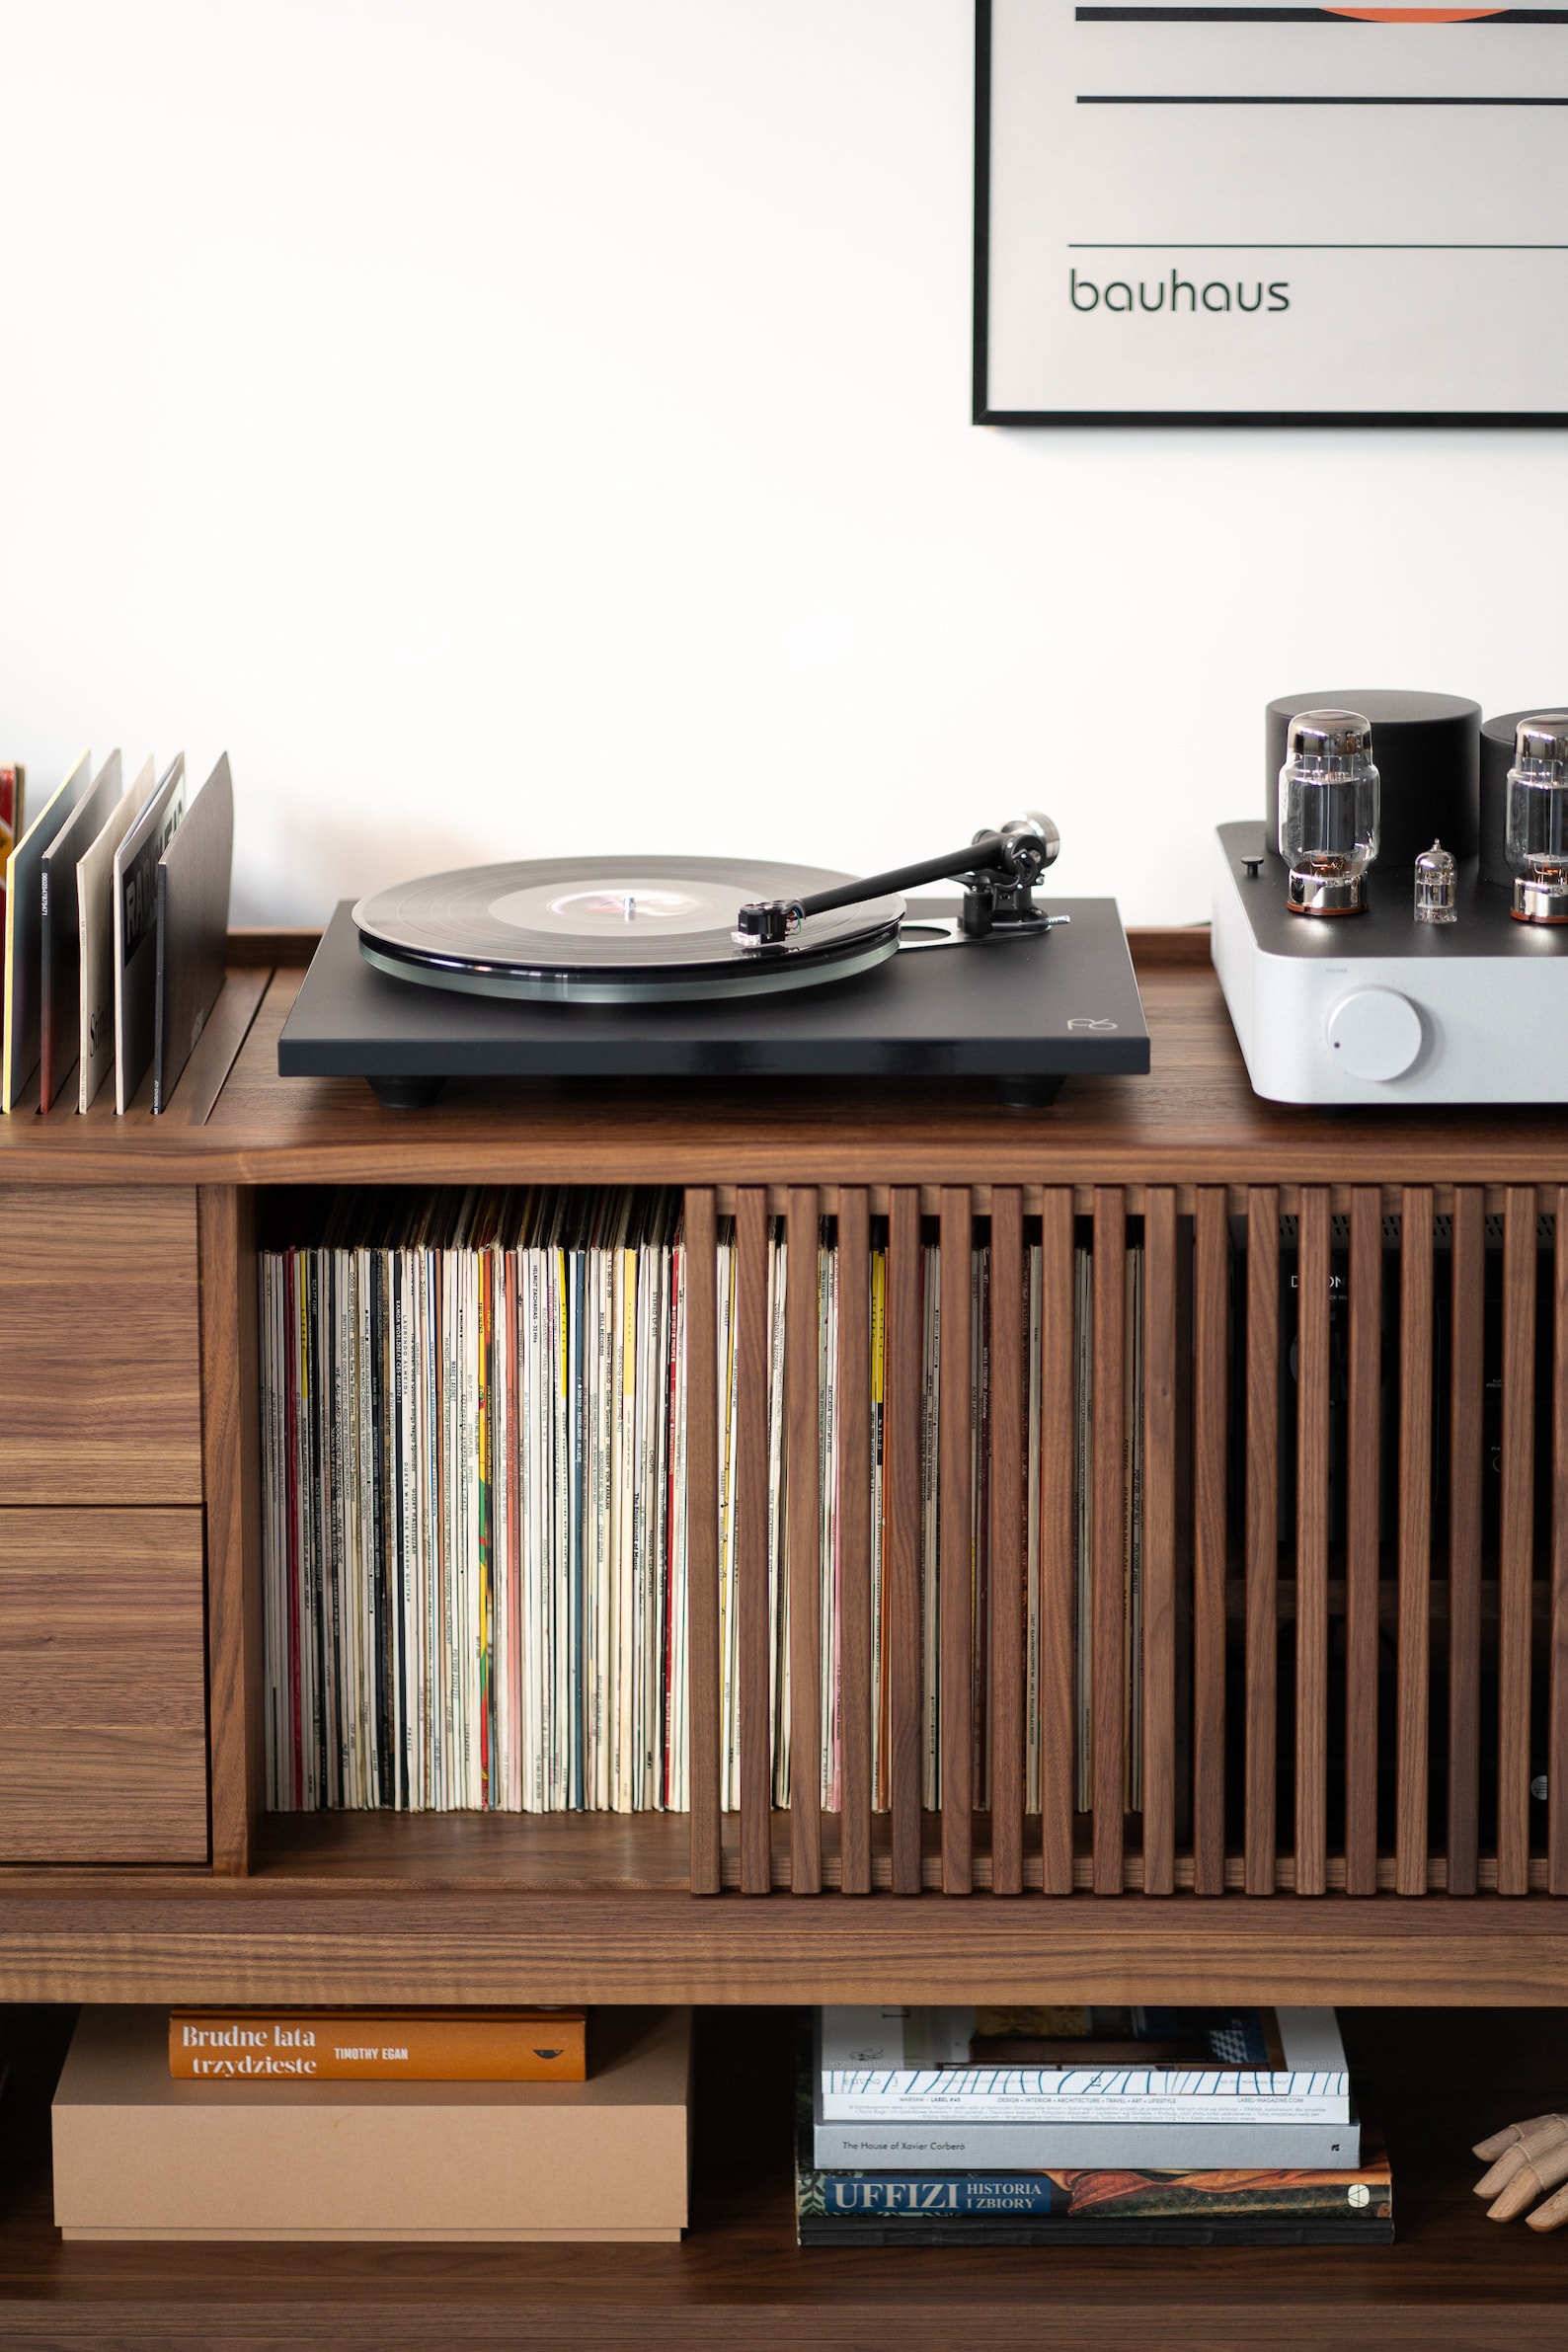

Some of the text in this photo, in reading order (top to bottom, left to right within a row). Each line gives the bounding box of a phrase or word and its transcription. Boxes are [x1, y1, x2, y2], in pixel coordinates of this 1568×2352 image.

[1069, 269, 1291, 312] bauhaus
[183, 2025, 316, 2047] Brudne lata
[335, 2048, 409, 2061] TIMOTHY EGAN
[193, 2056, 317, 2078] trzydzieste
[842, 2142, 859, 2151] The
[861, 2142, 888, 2151] House
[891, 2142, 900, 2151] of
[901, 2142, 927, 2151] Xavier
[833, 2182, 1042, 2209] UFFIZI HISTORIA
[976, 2198, 1036, 2209] ZBIORY
